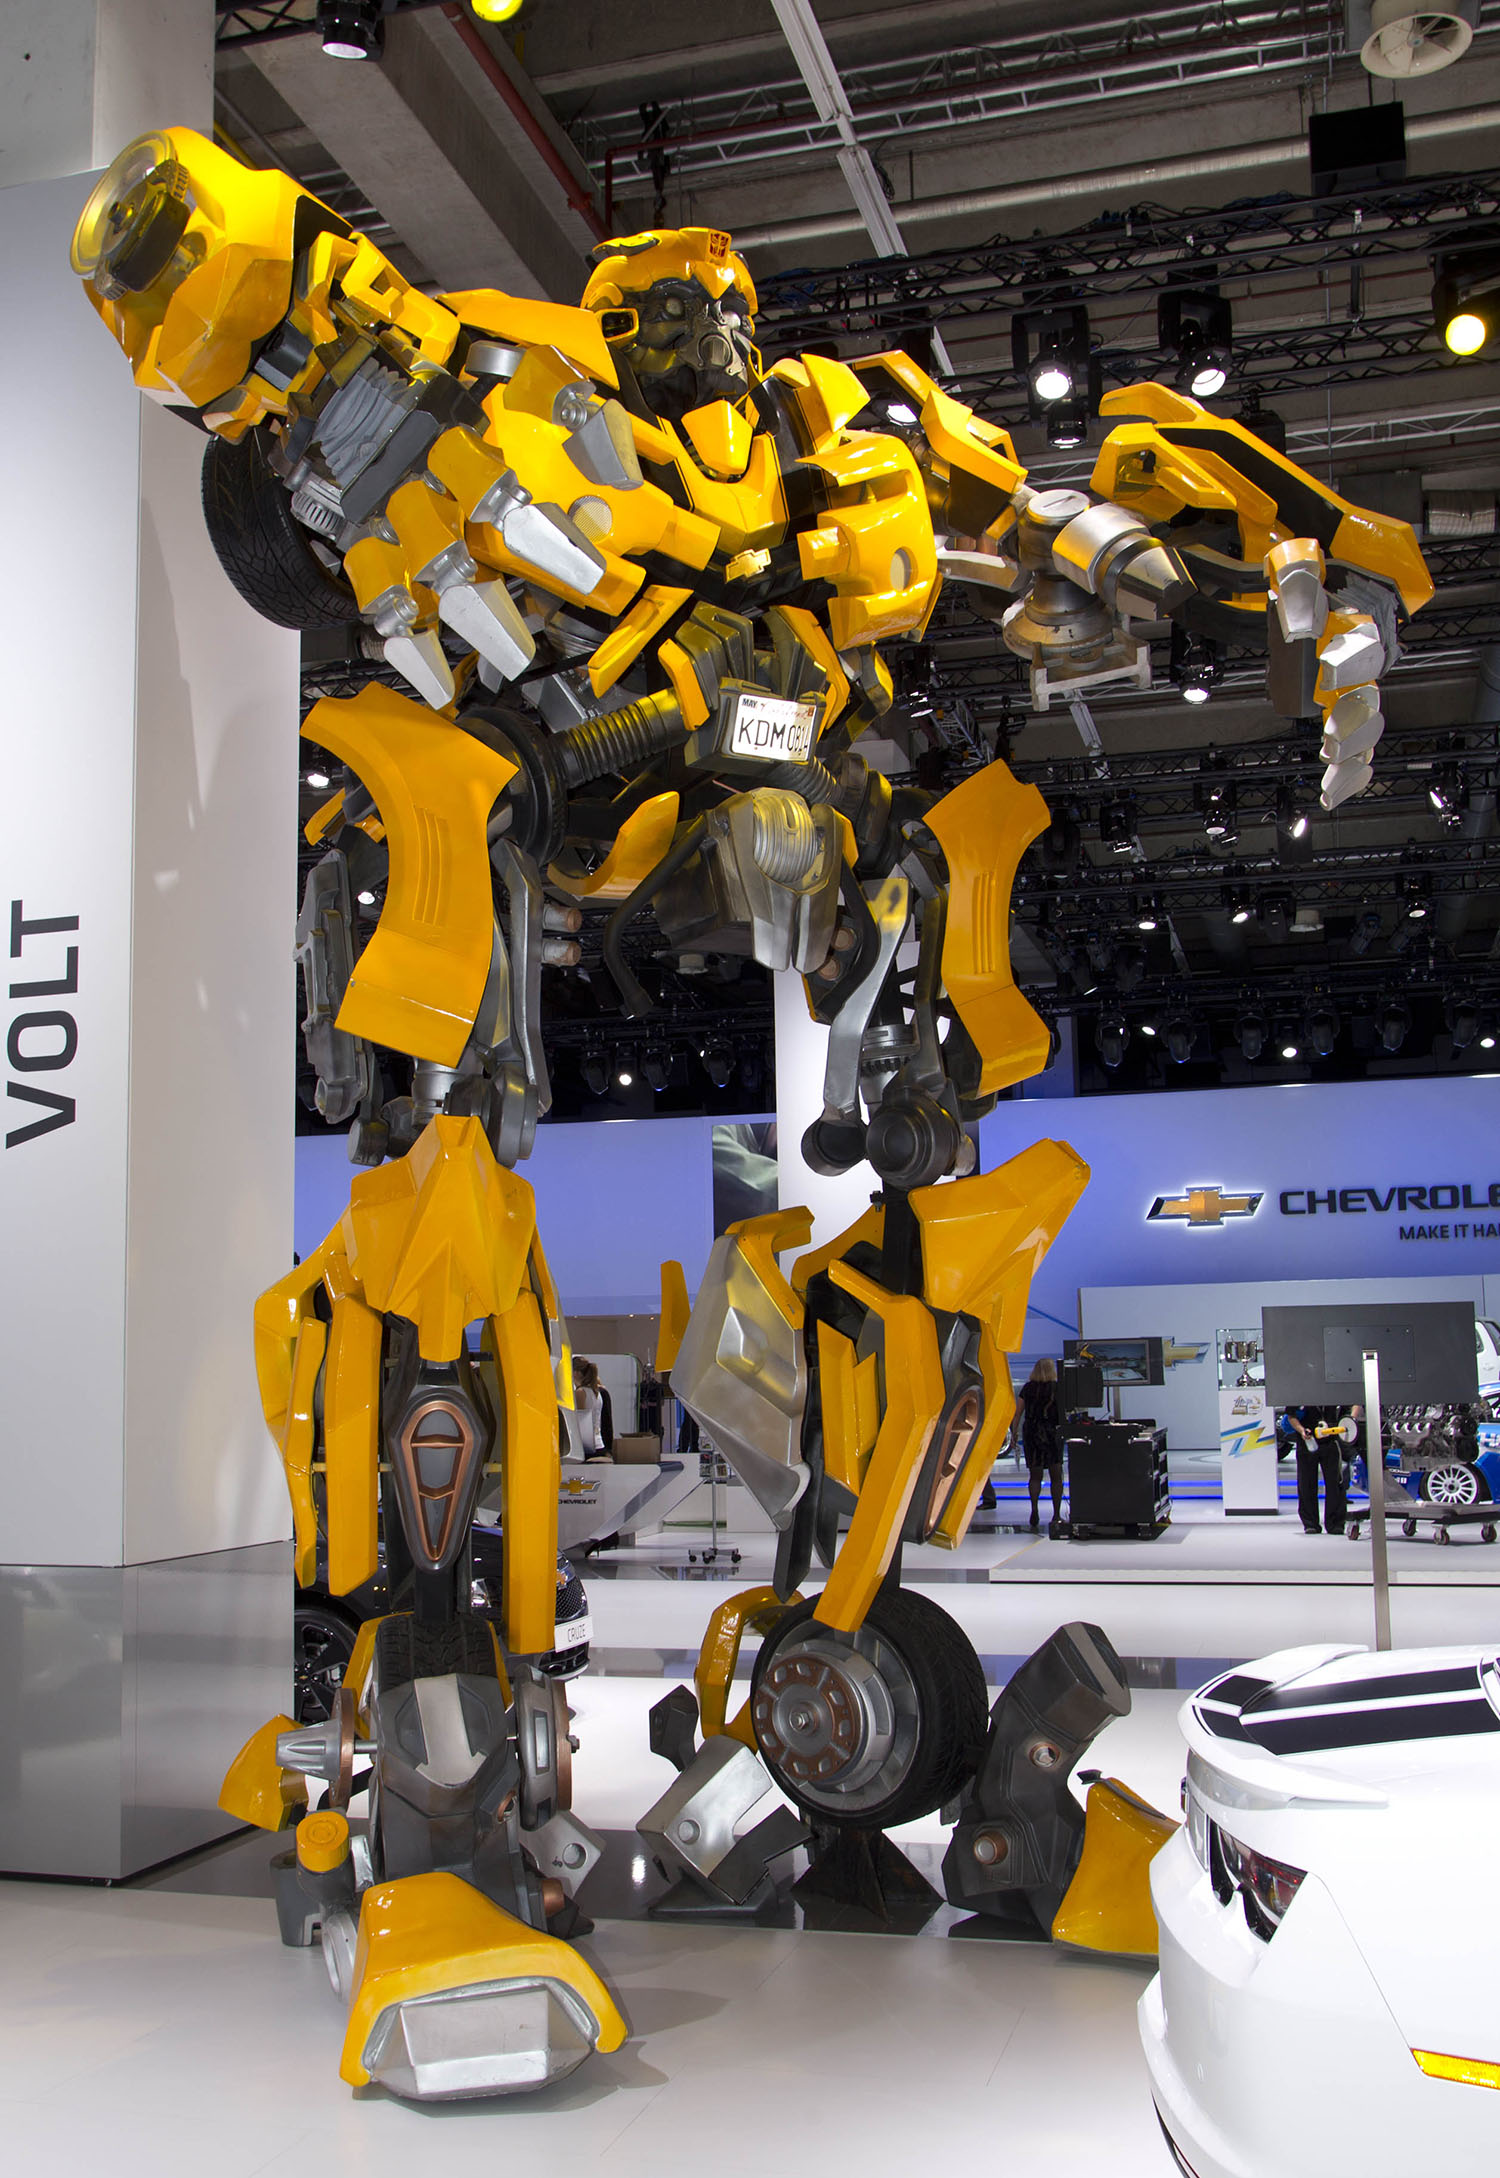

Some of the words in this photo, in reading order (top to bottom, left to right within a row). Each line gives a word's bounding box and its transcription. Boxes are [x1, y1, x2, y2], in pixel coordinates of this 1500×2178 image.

[742, 698, 758, 708] MAY
[6, 900, 79, 1149] VOLT
[1399, 1225, 1449, 1240] MAKE
[1454, 1224, 1469, 1238] IT
[1473, 1223, 1500, 1238] HA
[568, 1624, 585, 1642] CRUZE
